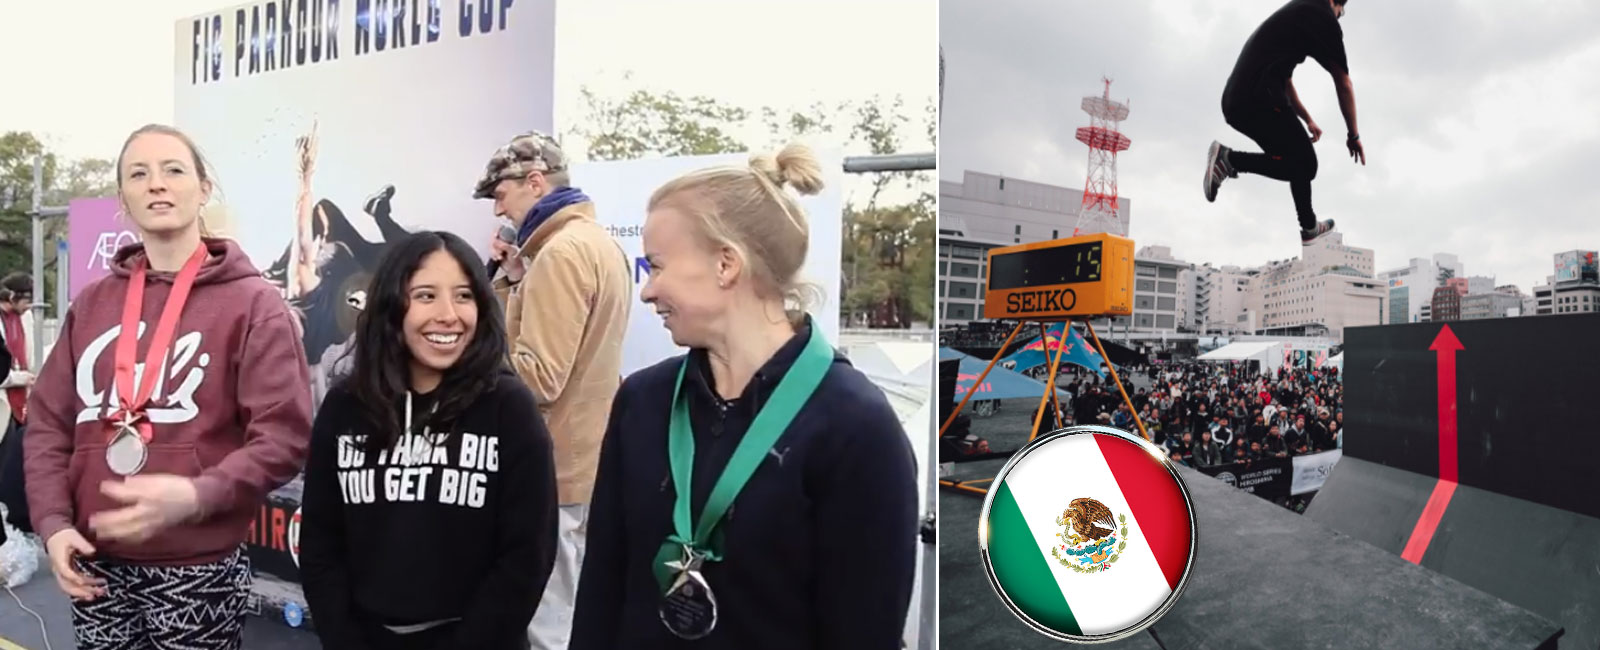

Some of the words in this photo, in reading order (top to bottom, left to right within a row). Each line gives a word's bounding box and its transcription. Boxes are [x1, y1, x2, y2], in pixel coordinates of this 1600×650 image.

[192, 15, 221, 84] FIG
[235, 0, 338, 76] PARKOUR
[355, 0, 440, 55] WORLD
[1006, 288, 1076, 313] SEIKO
[459, 432, 499, 472] BIG
[337, 468, 375, 504] YOU
[384, 466, 433, 501] GET
[439, 468, 487, 508] BIG
